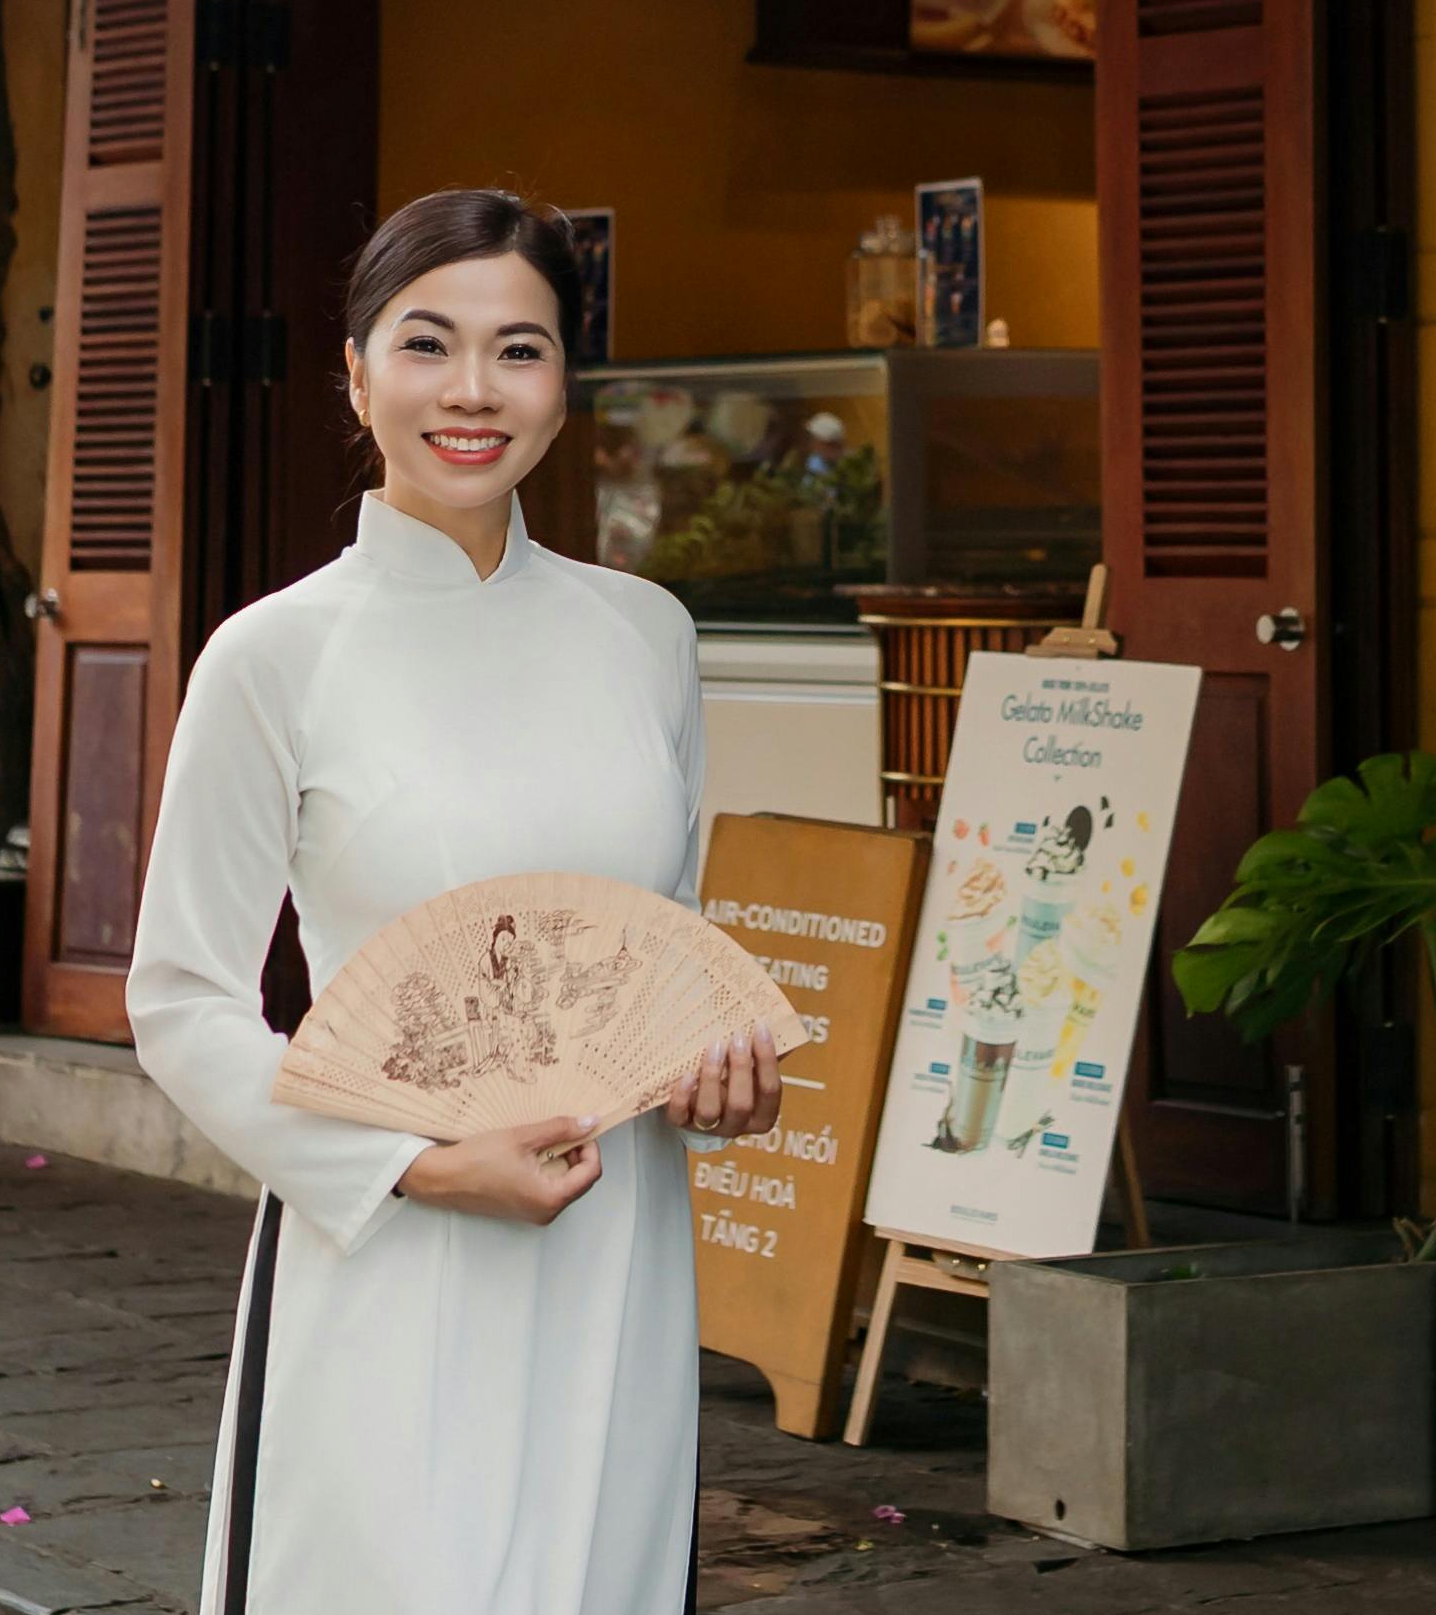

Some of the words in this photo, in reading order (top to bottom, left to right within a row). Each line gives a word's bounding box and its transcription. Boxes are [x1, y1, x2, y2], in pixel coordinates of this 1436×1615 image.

[1001, 693, 1052, 723] Gelato
[1057, 697, 1143, 731] MilkShake
[1023, 735, 1102, 768] Collection
[702, 898, 887, 948] AIR-CONDITIONED
[760, 1230, 778, 1258] 2
